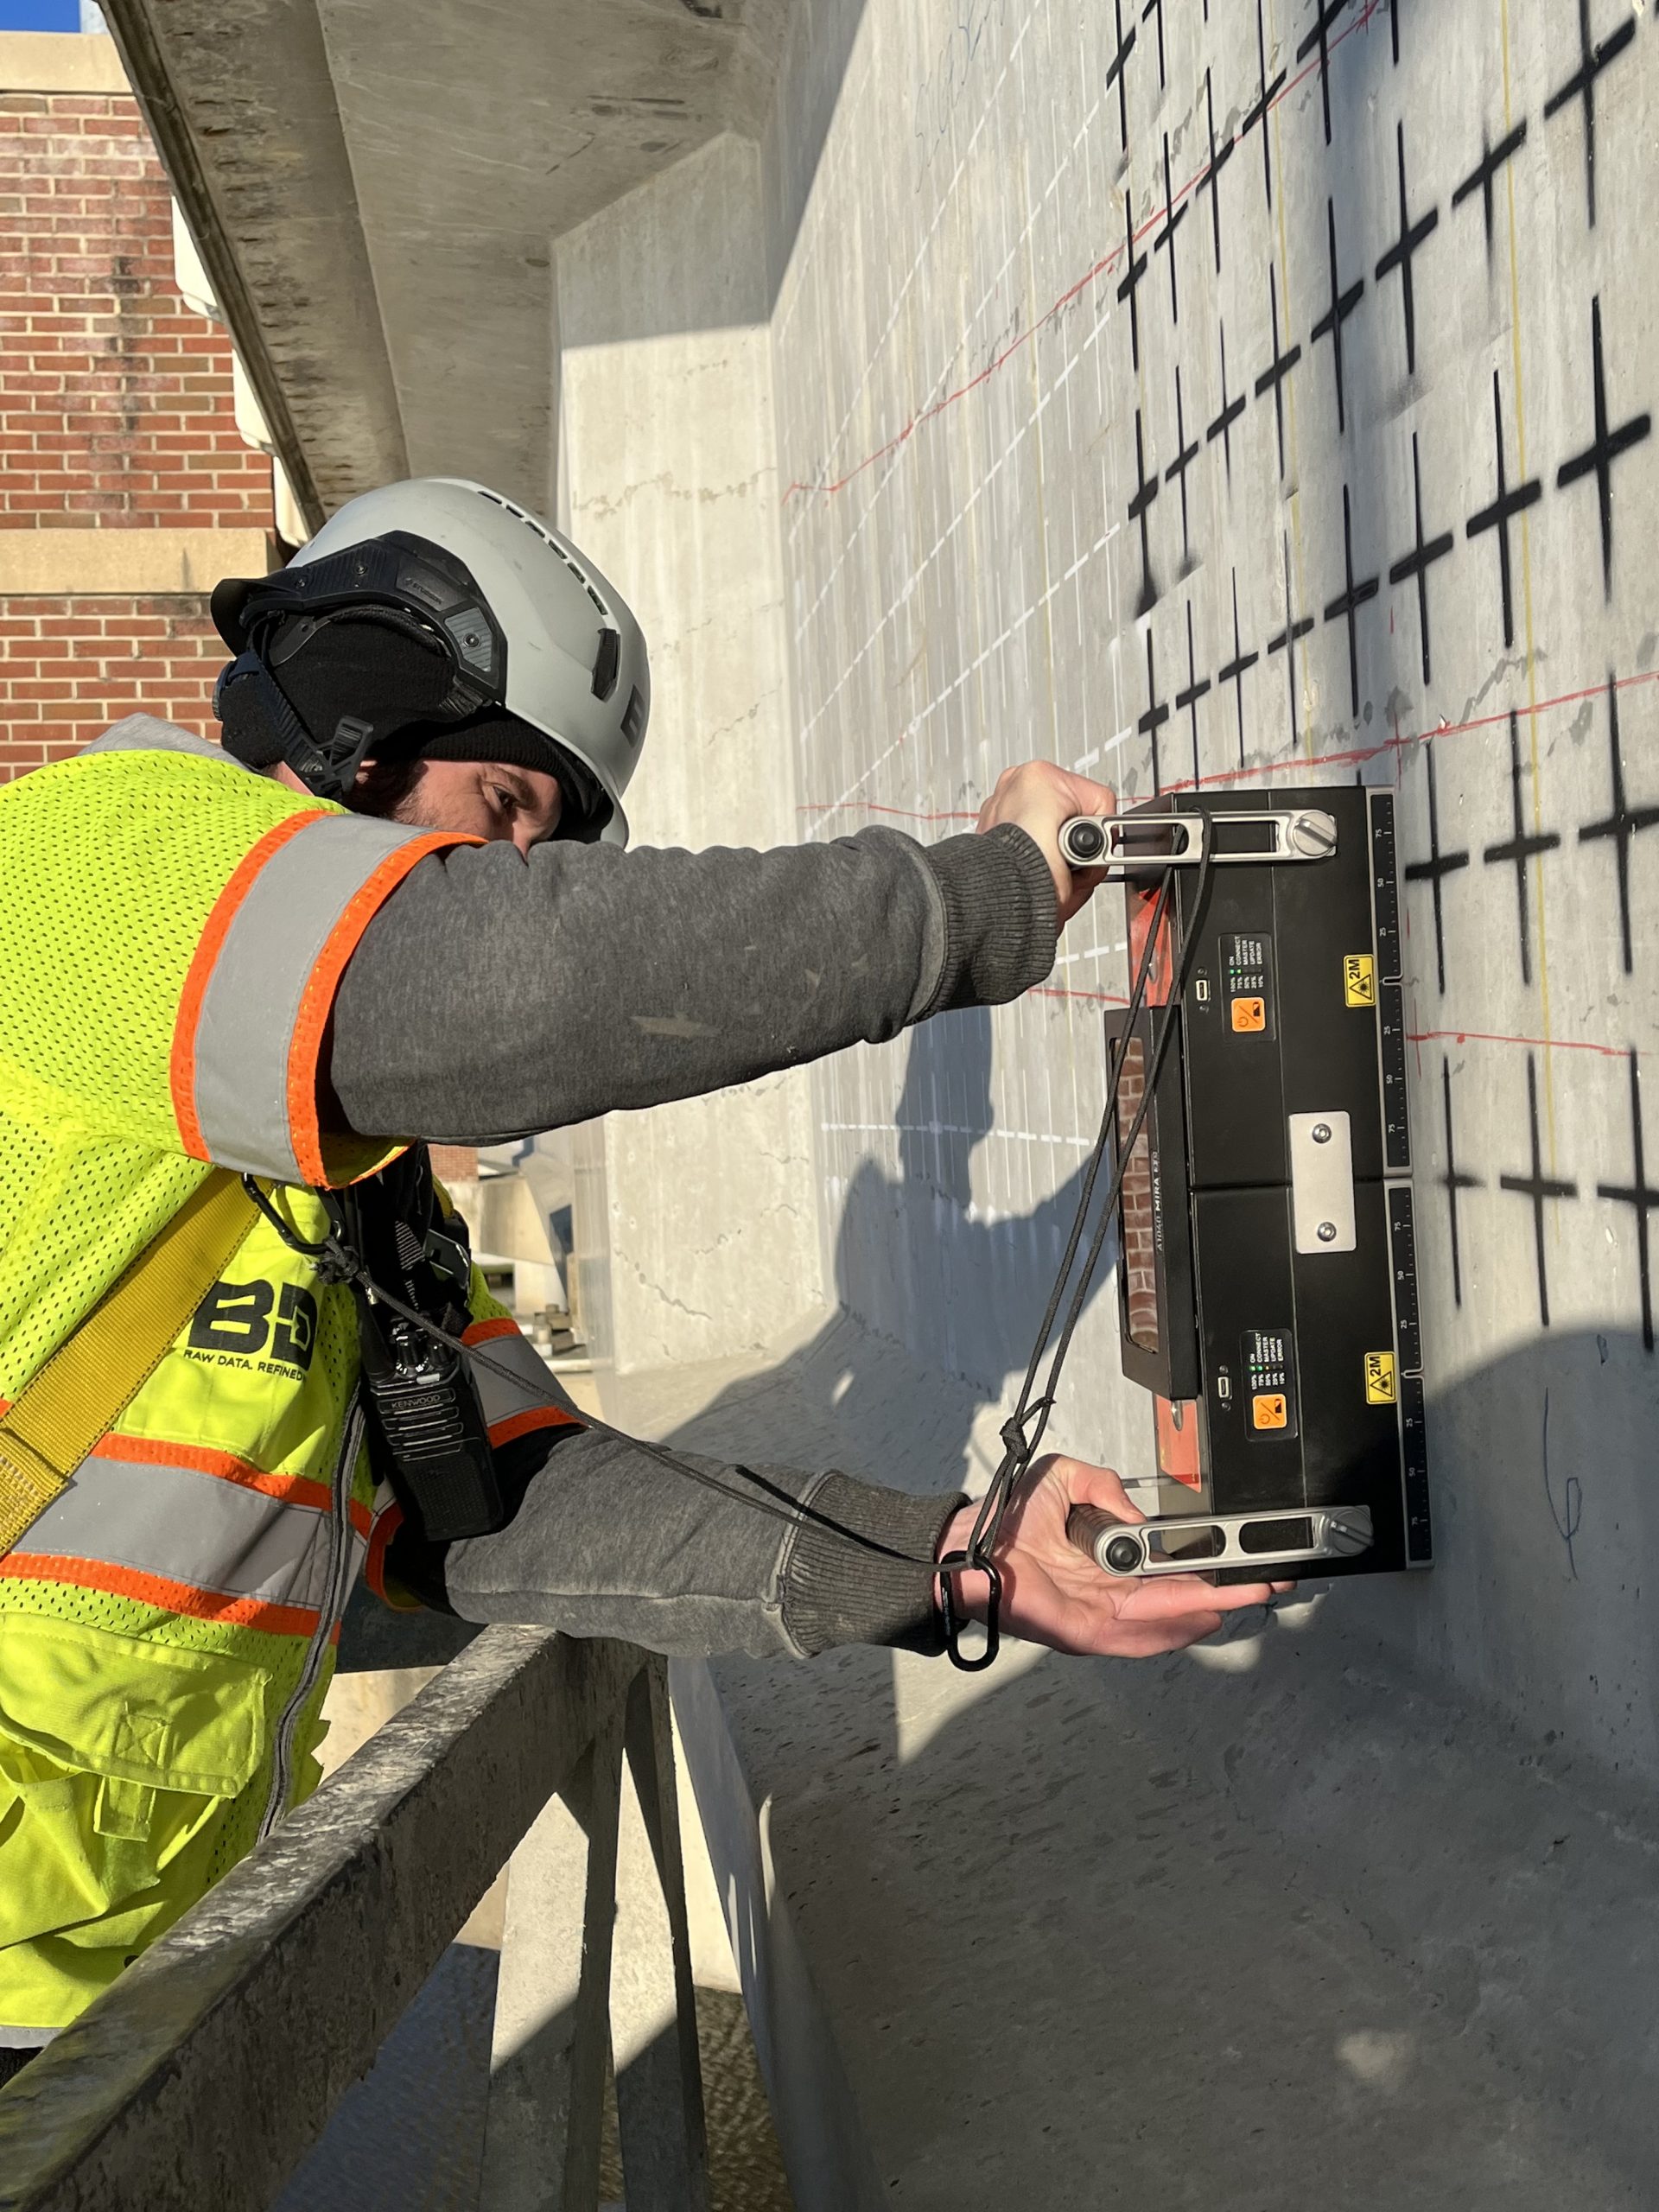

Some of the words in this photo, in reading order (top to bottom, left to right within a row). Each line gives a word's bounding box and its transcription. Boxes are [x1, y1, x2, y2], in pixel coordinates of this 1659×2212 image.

[1375, 829, 1382, 838] 75
[1377, 878, 1384, 887] 50
[1379, 927, 1386, 937] 25
[1229, 956, 1235, 966] ON
[1349, 959, 1361, 980] 2M
[1383, 1026, 1391, 1035] 25
[1386, 1075, 1393, 1084] 50
[1389, 1123, 1395, 1134] 75
[1395, 1221, 1402, 1231] 75
[1397, 1270, 1404, 1281] 50
[1401, 1319, 1408, 1329] 25
[183, 1349, 214, 1363] RAW
[217, 1355, 253, 1370] DATA.
[1249, 1353, 1255, 1363] ON
[1369, 1356, 1381, 1377] 2M
[391, 1395, 441, 1408] KENWOOD
[1406, 1417, 1414, 1427] 25
[1408, 1466, 1415, 1477] 50
[1411, 1516, 1418, 1526] 75
